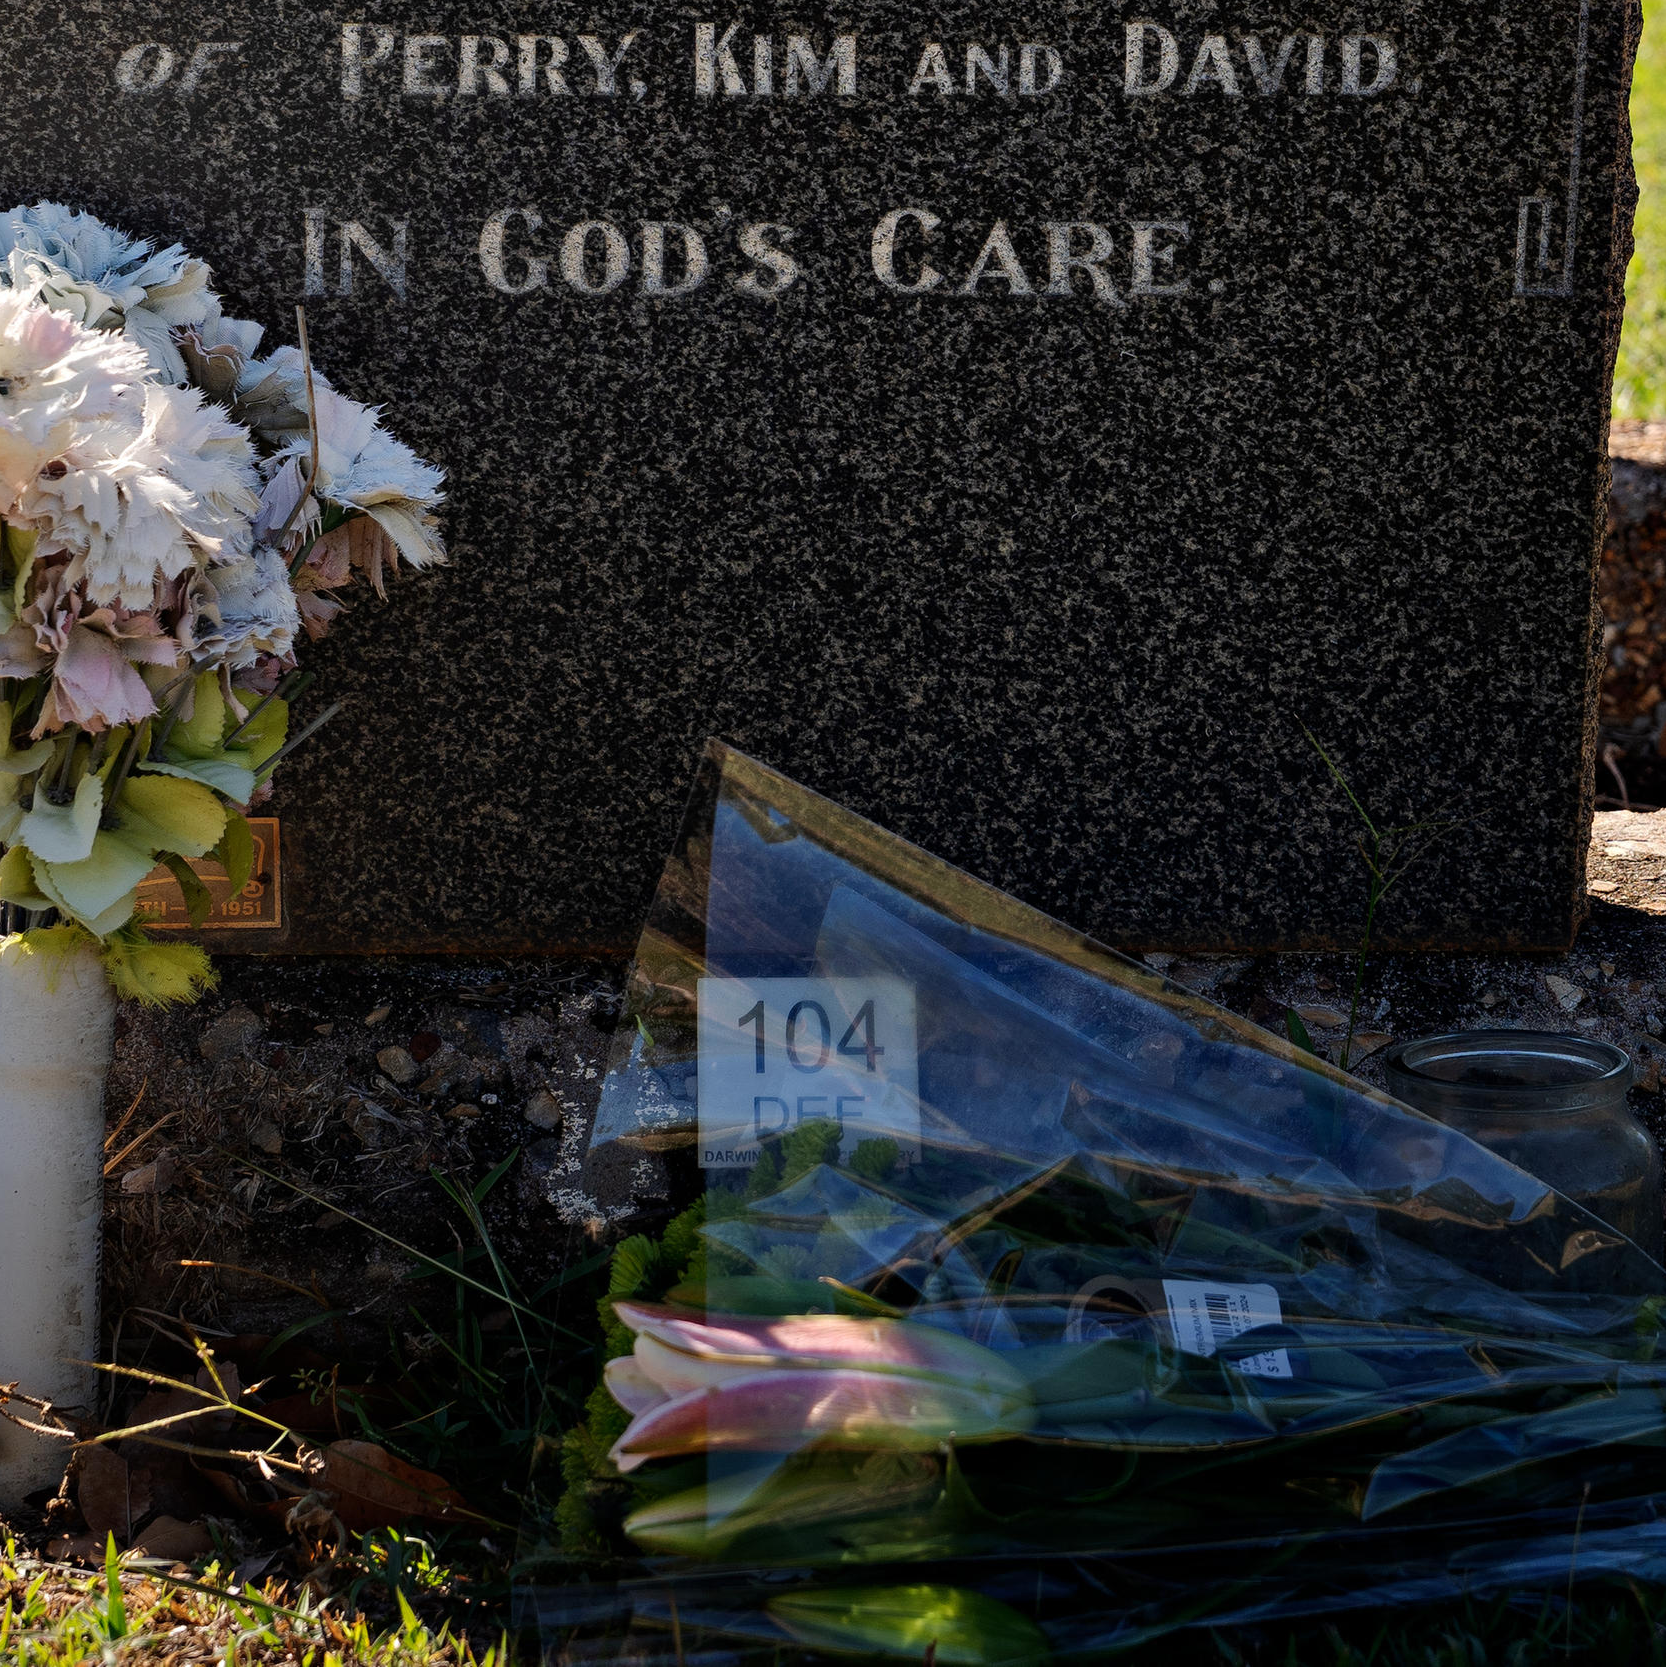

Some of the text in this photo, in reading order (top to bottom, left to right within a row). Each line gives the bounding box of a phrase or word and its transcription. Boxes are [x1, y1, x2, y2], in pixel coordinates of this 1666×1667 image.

[113, 40, 241, 96] OF
[691, 20, 859, 98] KIM
[907, 40, 1065, 98] AND
[301, 204, 1228, 308] IN GOD'S CARE.
[221, 900, 262, 917] 1951
[737, 998, 885, 1075] 104
[704, 1149, 761, 1164] DARWIN
